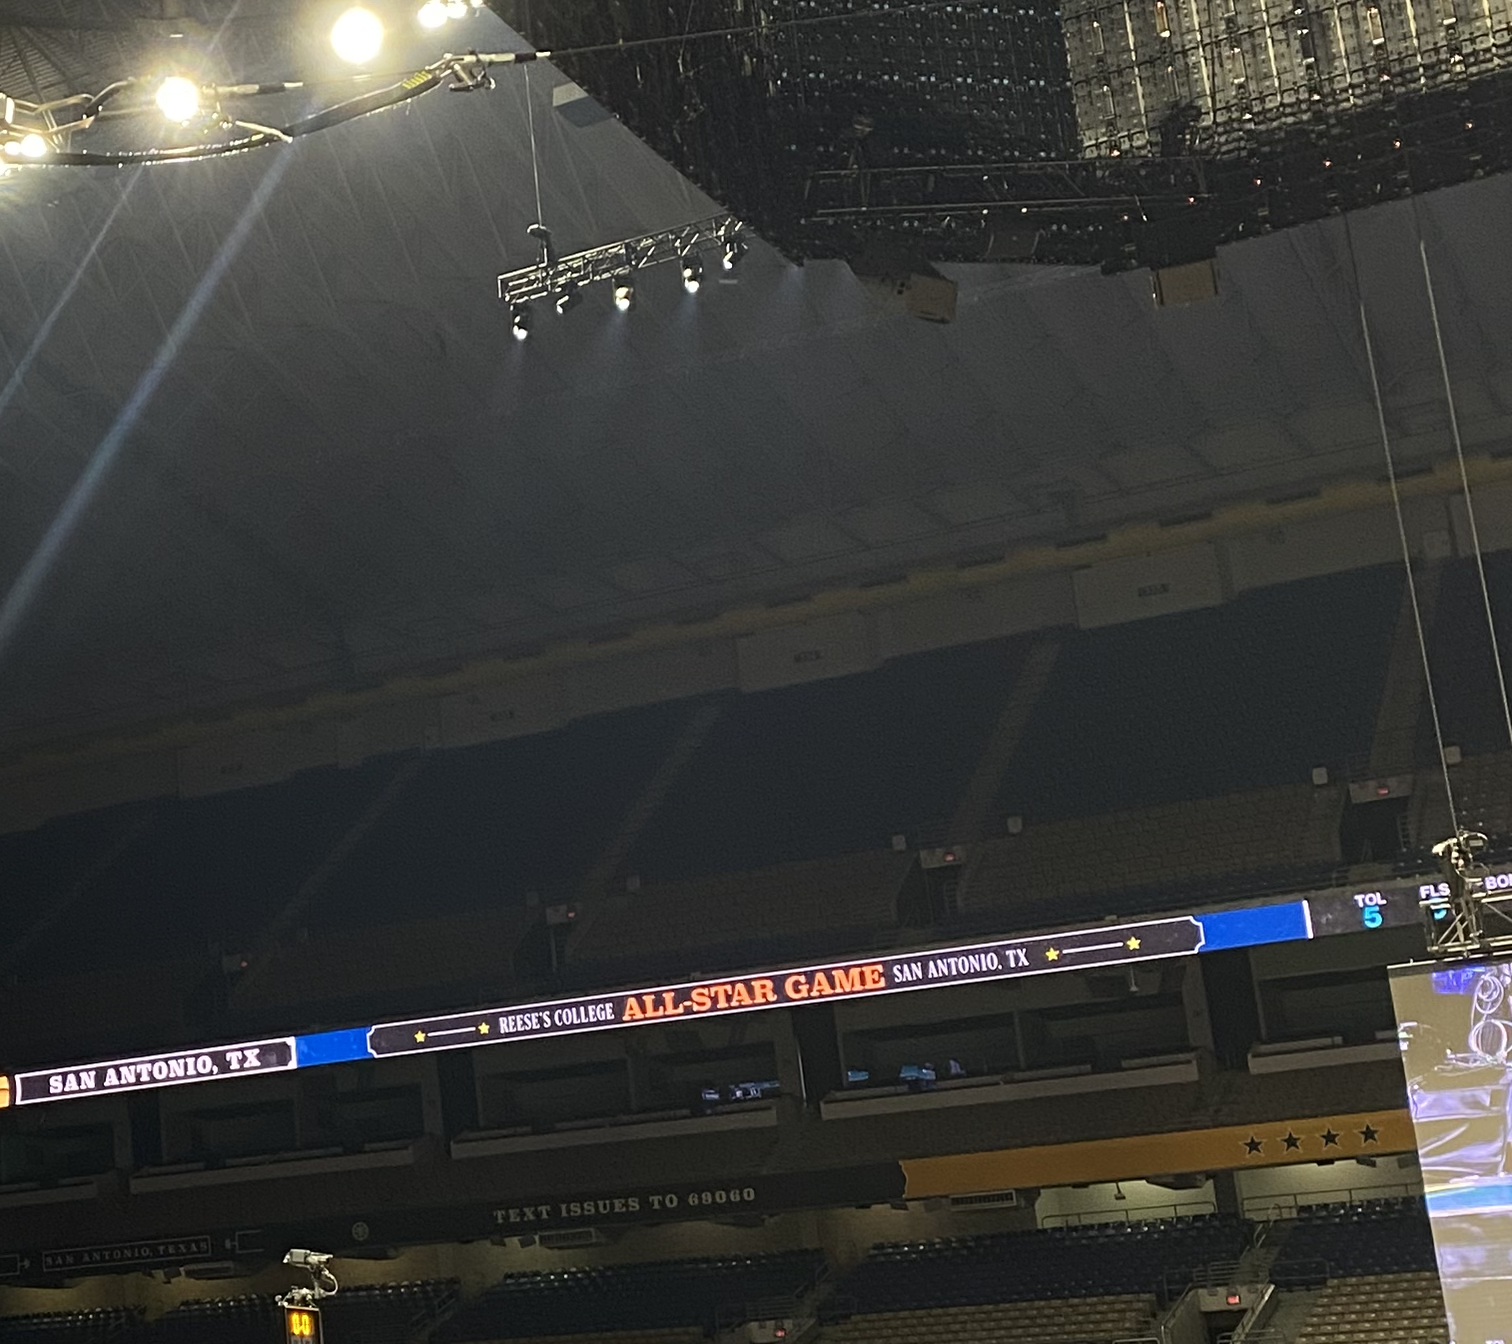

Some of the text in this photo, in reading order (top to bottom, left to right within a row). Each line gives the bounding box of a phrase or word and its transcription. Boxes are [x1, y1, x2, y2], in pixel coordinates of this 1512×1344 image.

[1354, 874, 1512, 908] TOL FLS BO
[1362, 905, 1383, 929] 5
[499, 1010, 551, 1035] REESE'S
[554, 1002, 615, 1028] COLLEGE
[622, 979, 777, 1022] ALL-STAR
[784, 964, 886, 1002] GAME
[893, 961, 925, 984] SAN
[1005, 947, 1029, 970] TX
[49, 1048, 261, 1096] SAN ANTONIO, TX
[493, 1206, 550, 1223] TEXT
[560, 1197, 640, 1217] ISSUES
[648, 1193, 679, 1210] TO
[45, 1254, 75, 1267] SAN
[157, 1241, 208, 1256] TEXAS
